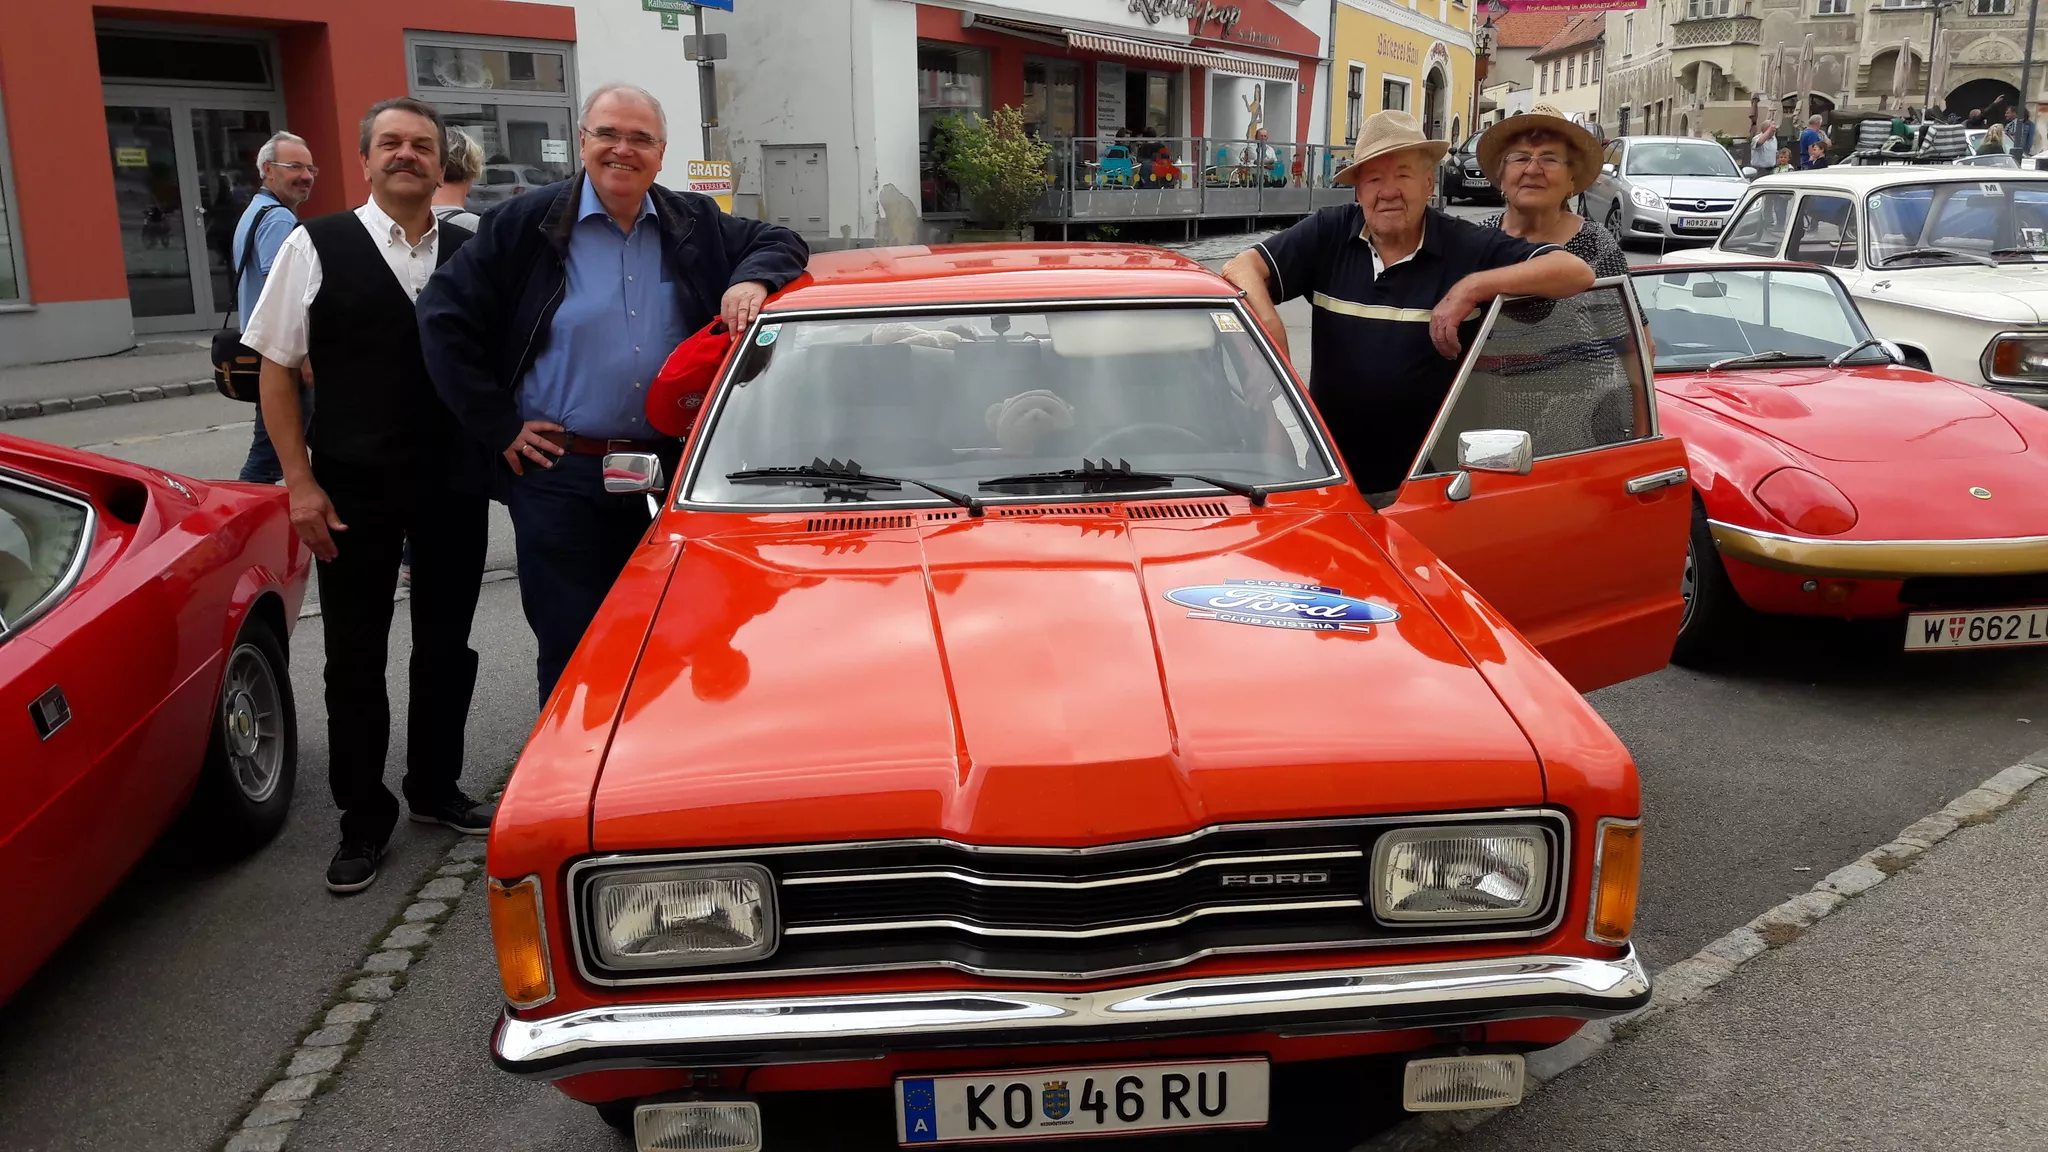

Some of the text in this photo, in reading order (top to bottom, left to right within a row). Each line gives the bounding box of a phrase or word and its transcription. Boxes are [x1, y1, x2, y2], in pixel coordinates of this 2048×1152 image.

[666, 14, 674, 24] 2
[689, 163, 731, 177] GRATIS
[1244, 579, 1323, 592] CLASSIC
[1208, 588, 1352, 618] Ford
[1219, 614, 1335, 630] CLUB AUSTRIA
[1925, 614, 2048, 644] W 662 L
[1222, 873, 1328, 886] FORD
[966, 1070, 1227, 1131] KO 46 RU
[914, 1118, 928, 1132] A
